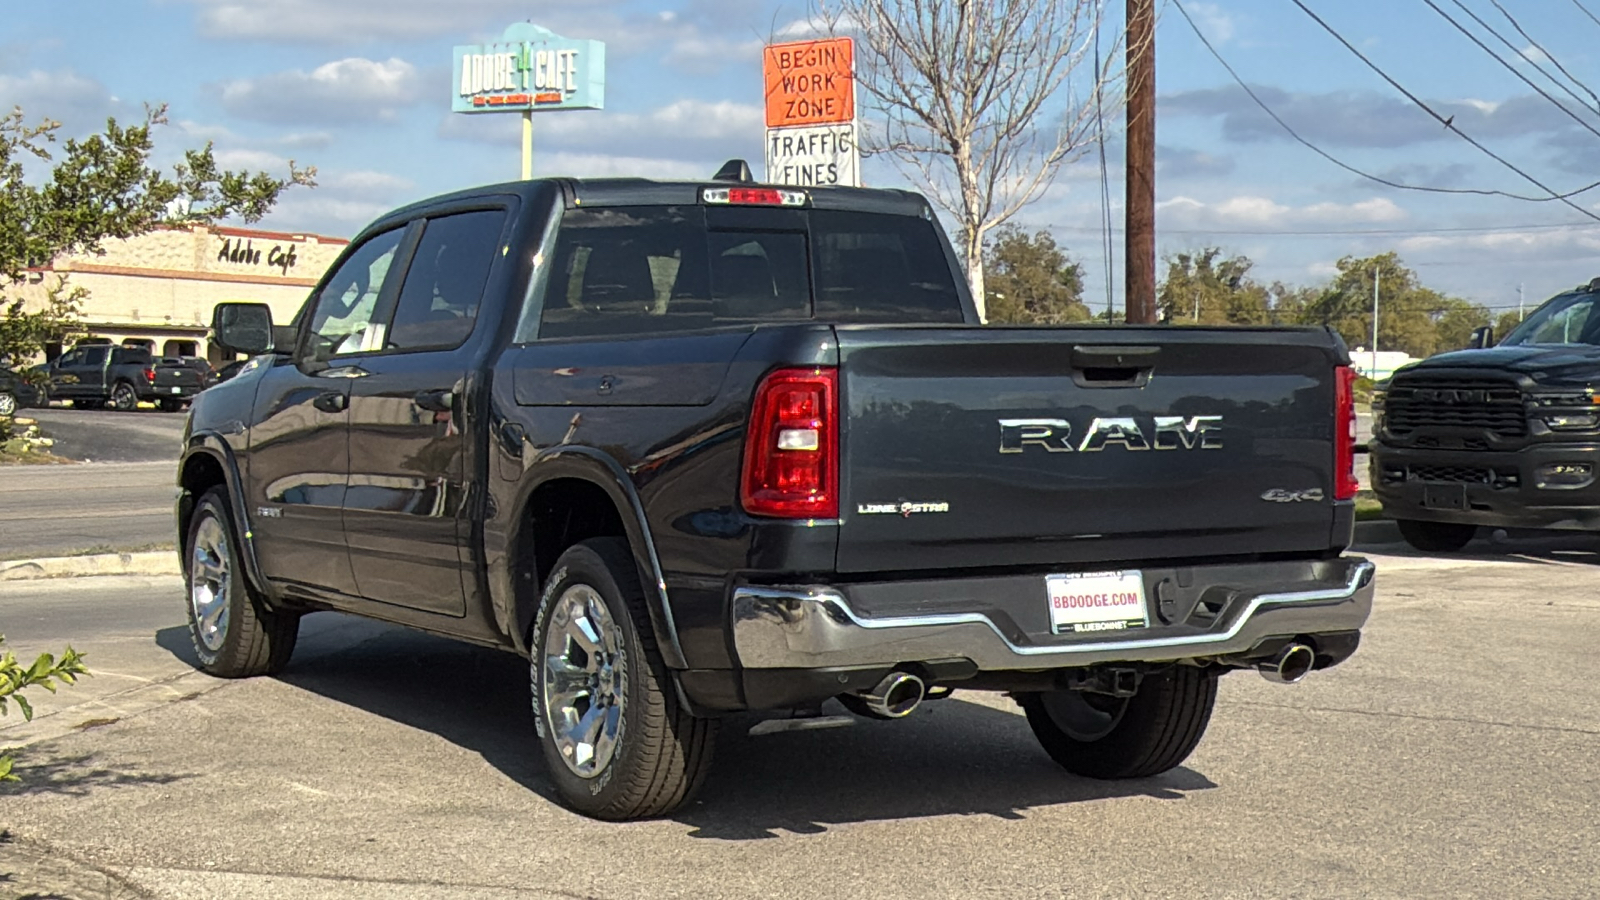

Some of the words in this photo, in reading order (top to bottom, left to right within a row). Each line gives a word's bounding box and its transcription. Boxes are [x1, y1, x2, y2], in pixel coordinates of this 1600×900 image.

[780, 46, 836, 69] BEGIN
[460, 52, 517, 97] ADOBE
[535, 49, 579, 92] CAFE
[782, 72, 836, 94] WORK
[785, 98, 836, 119] ZONE
[771, 132, 851, 157] TRAFFIC
[784, 163, 838, 185] FINES
[217, 238, 261, 265] Adobe
[998, 415, 1223, 453] RAM
[858, 504, 898, 514] LONE
[910, 502, 949, 512] STAR
[1053, 593, 1138, 608] BBDODGE.COM
[1073, 621, 1128, 632] BLUEBONNET
